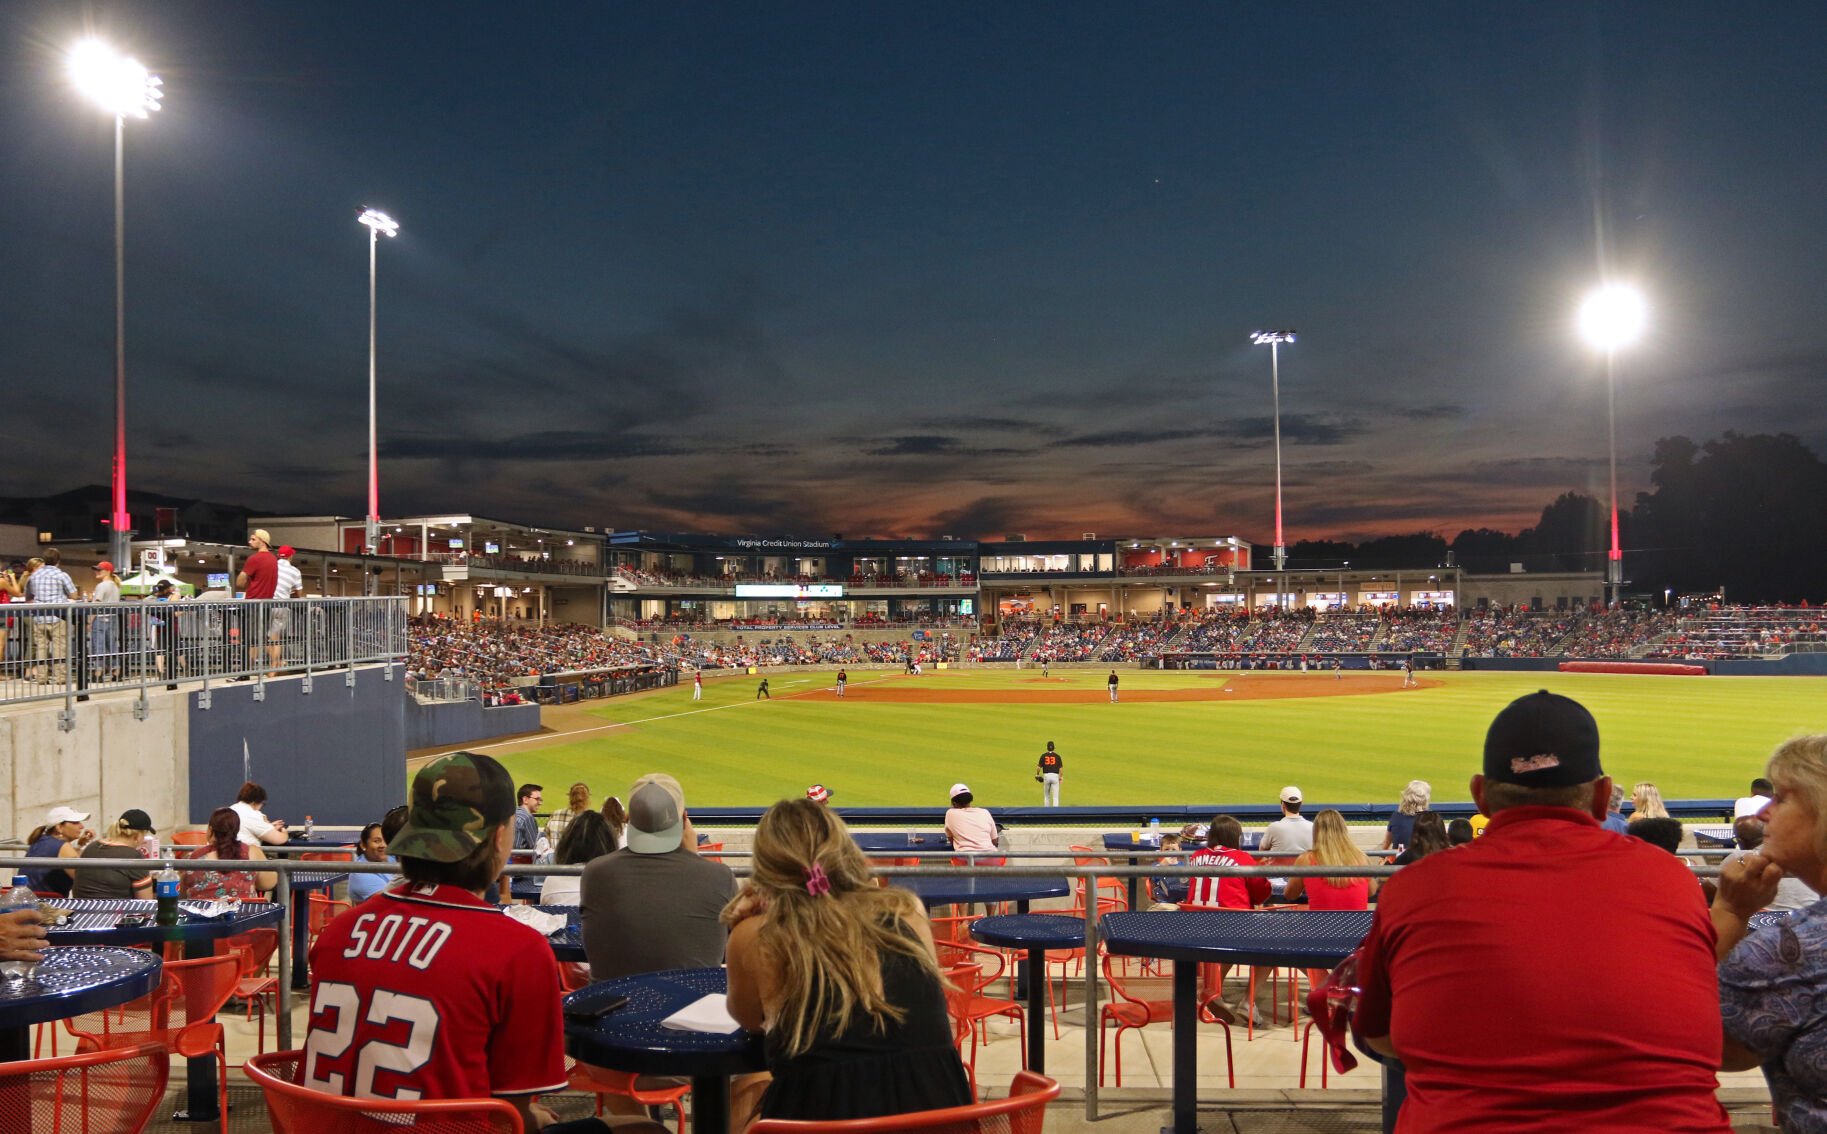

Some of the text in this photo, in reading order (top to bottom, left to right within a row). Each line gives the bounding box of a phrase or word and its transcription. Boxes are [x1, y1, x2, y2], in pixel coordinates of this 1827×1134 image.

[737, 540, 761, 548] Virginia
[802, 540, 829, 548] Stadium
[1044, 756, 1056, 765] 33
[1192, 876, 1220, 907] 11
[343, 912, 452, 970] SOTO
[304, 981, 440, 1101] 22
